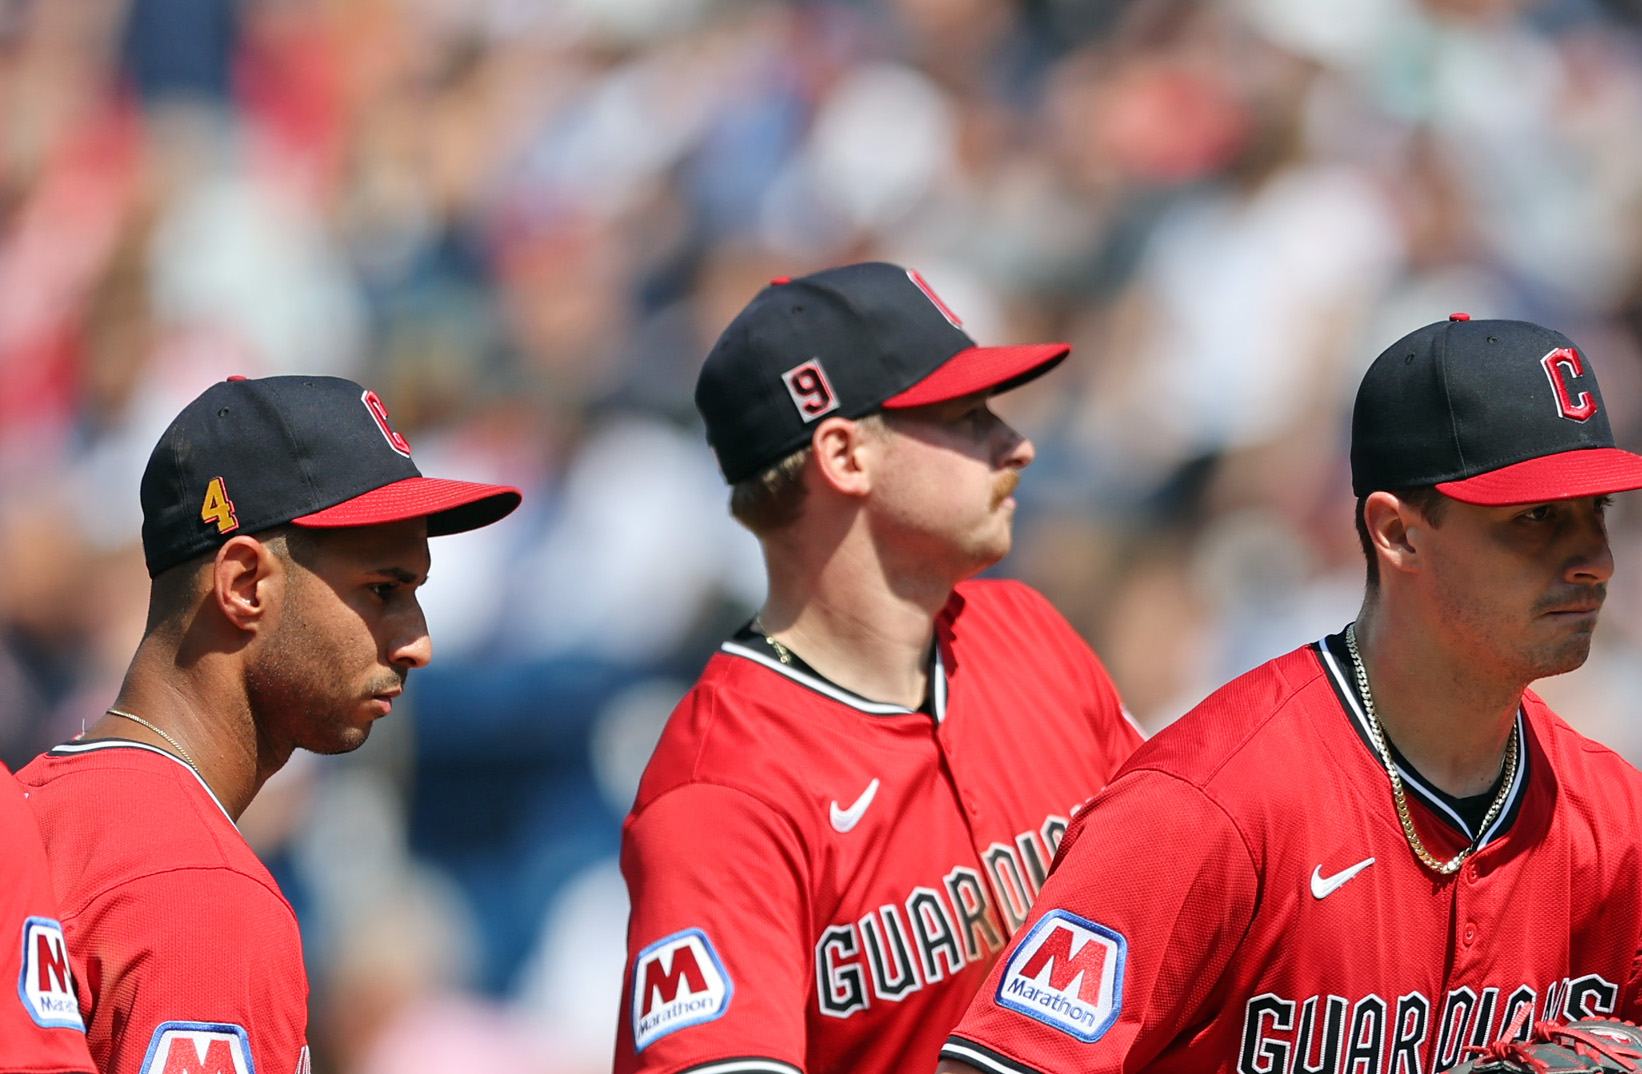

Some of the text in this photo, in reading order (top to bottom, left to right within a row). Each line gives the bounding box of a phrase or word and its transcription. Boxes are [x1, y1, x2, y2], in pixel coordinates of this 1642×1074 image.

[789, 362, 834, 419] 9
[1540, 347, 1598, 424] C
[201, 476, 239, 534] 4
[640, 945, 710, 1020] M
[1018, 925, 1109, 1009] M
[637, 998, 714, 1037] Marathon
[1007, 977, 1096, 1028] Marathon
